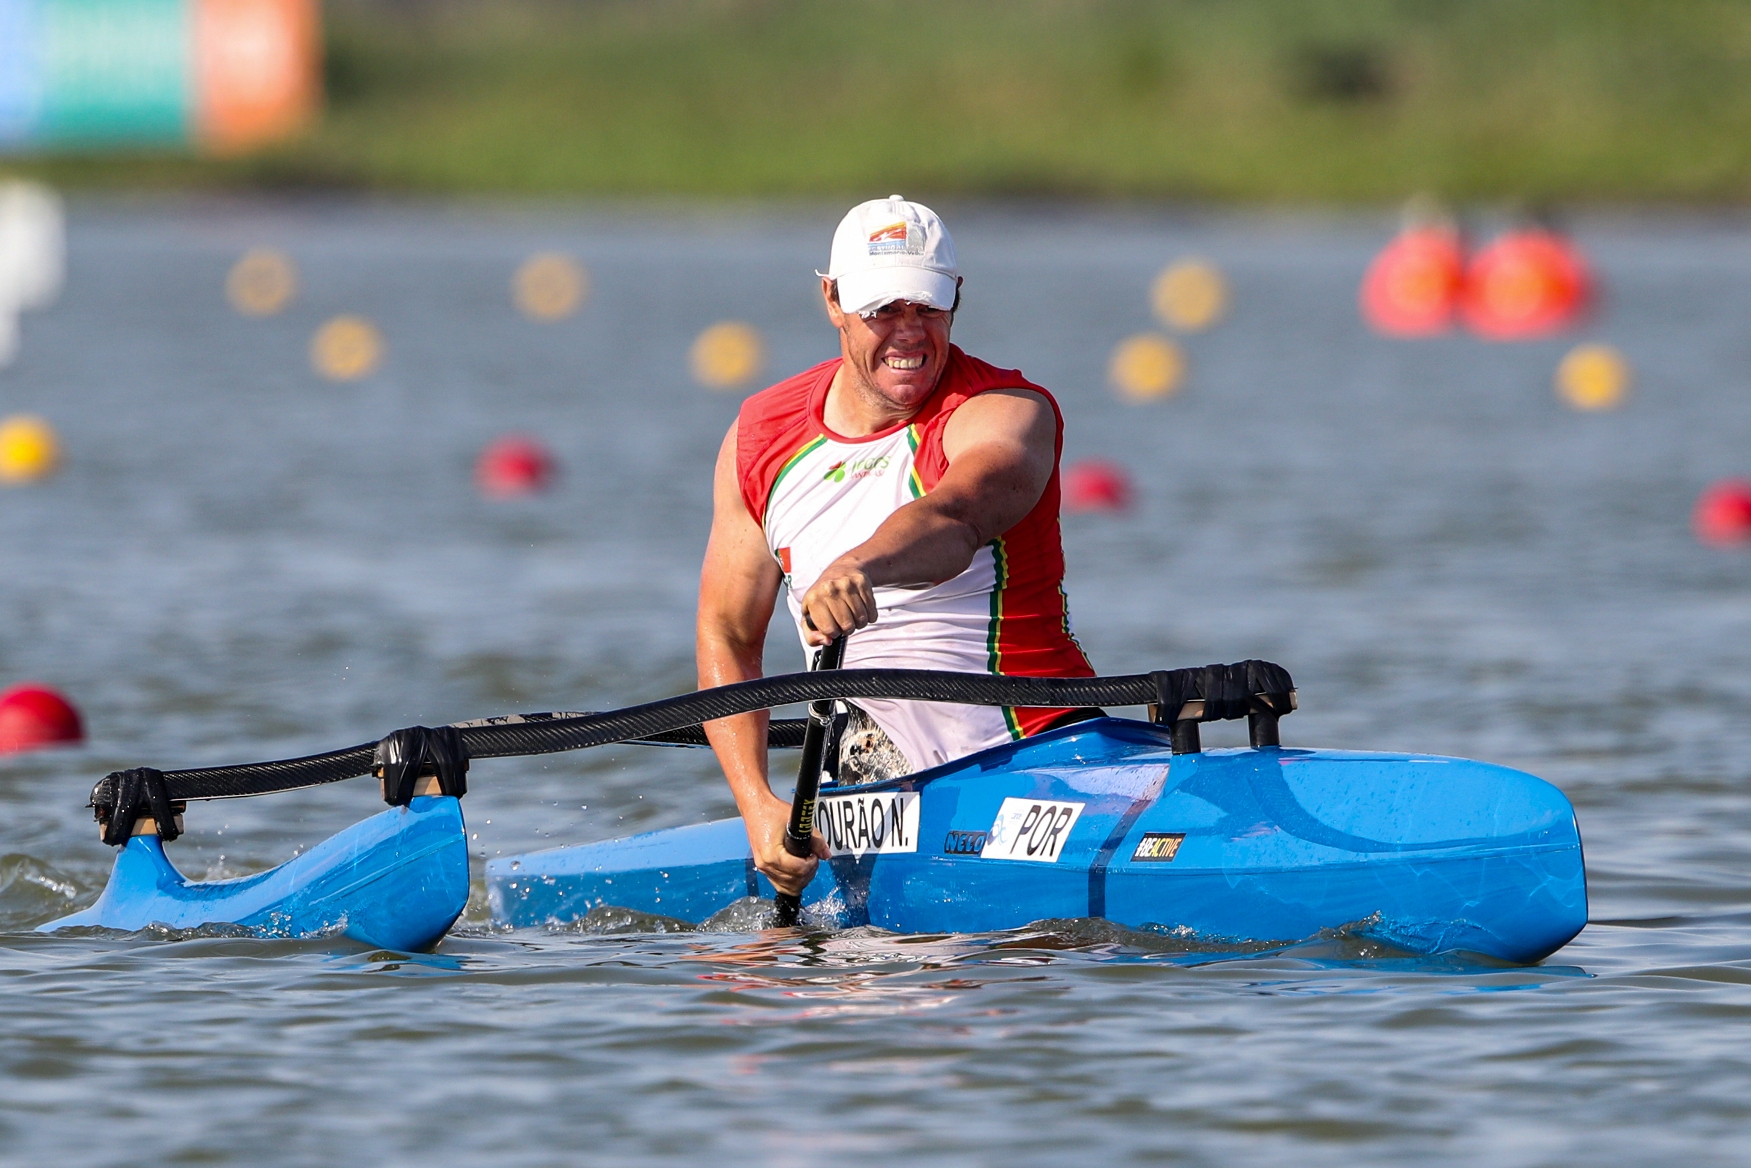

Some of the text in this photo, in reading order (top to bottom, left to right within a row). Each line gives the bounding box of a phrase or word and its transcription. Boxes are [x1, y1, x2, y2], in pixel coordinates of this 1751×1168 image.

[815, 797, 908, 850] OURÃO N.
[1009, 804, 1073, 857] POR
[945, 833, 985, 853] NELO
[1134, 837, 1183, 858] #BEACTIVE
